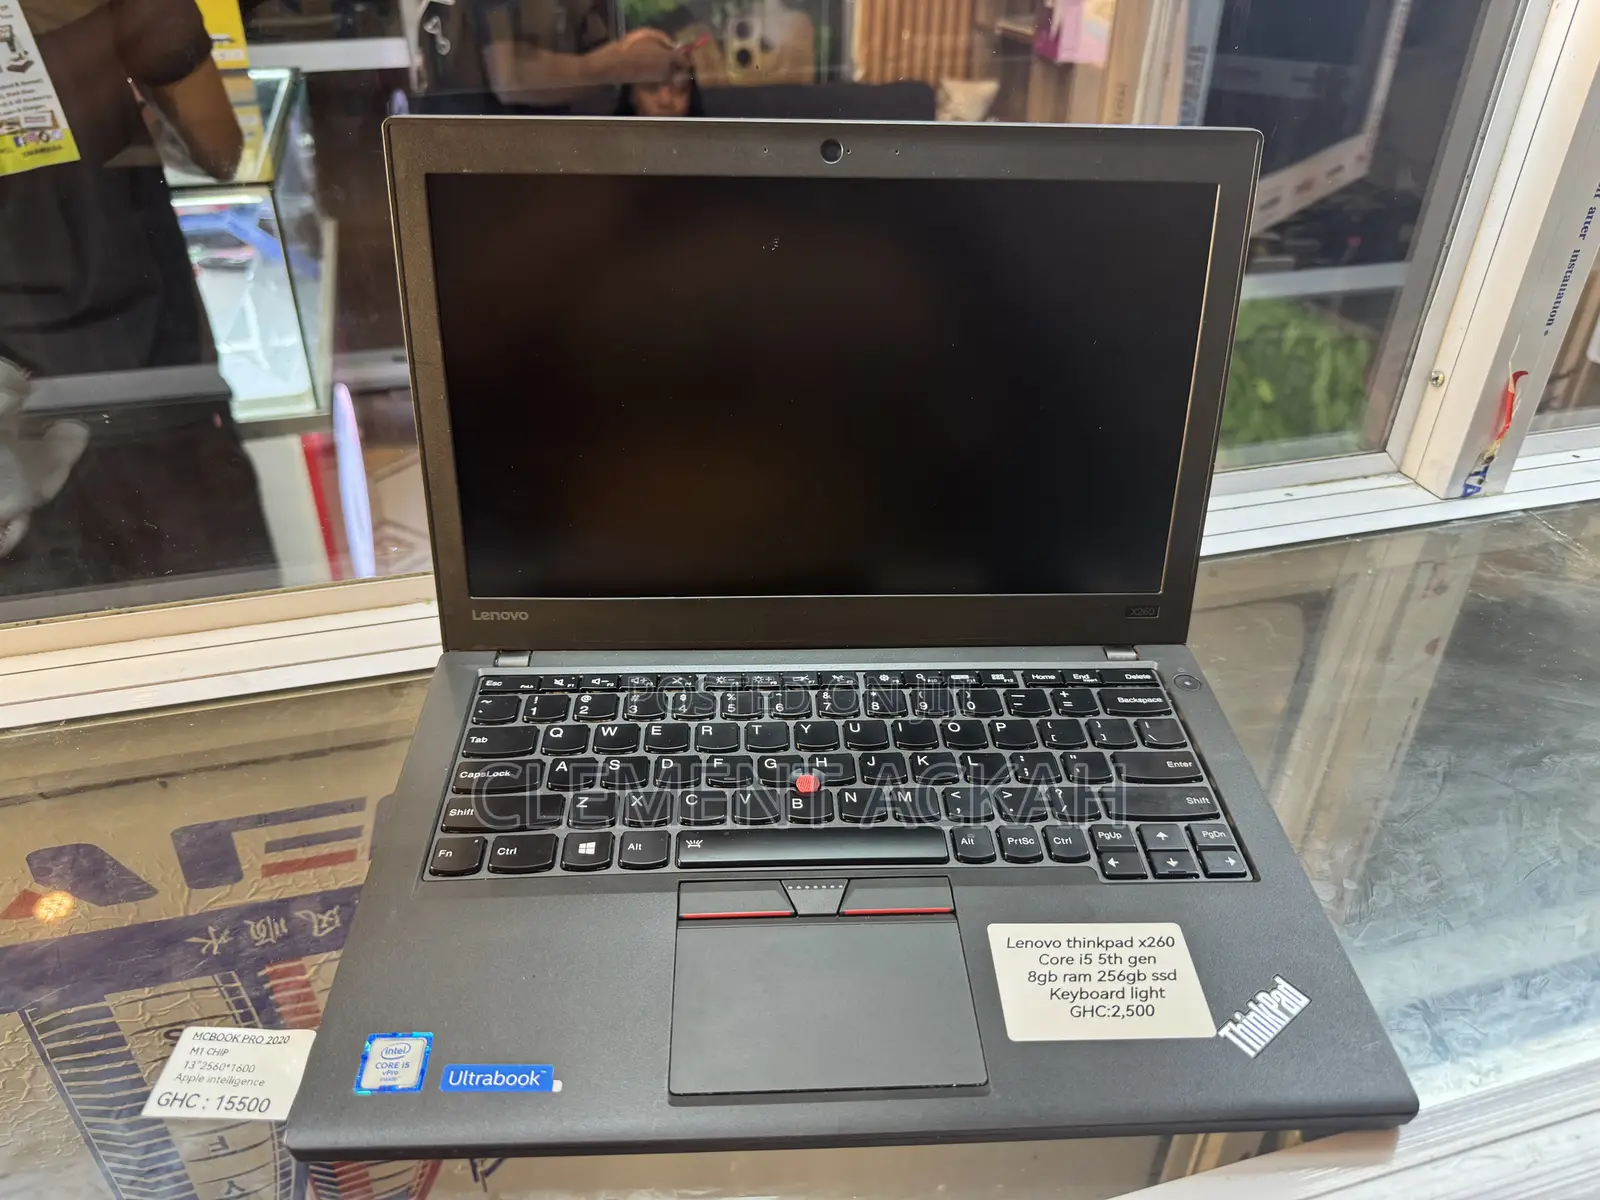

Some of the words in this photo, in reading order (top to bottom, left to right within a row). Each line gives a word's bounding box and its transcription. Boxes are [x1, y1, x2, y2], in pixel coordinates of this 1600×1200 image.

[472, 609, 529, 621] Lenovo
[1117, 696, 1162, 704] Backspace
[579, 705, 589, 714] 2
[628, 705, 638, 714] 3
[678, 704, 688, 713] 4
[727, 703, 736, 712] 5
[775, 703, 784, 711] 6
[823, 702, 832, 711] 7
[871, 701, 880, 710] 8
[919, 701, 928, 710] 9
[530, 706, 537, 716] 1
[601, 726, 618, 736] W
[651, 725, 662, 735] E
[701, 725, 713, 735] R
[751, 725, 762, 734] T
[800, 724, 811, 733] Y
[849, 723, 860, 732] U
[995, 722, 1007, 731] P
[550, 727, 564, 738] Q
[609, 760, 621, 770] S
[661, 759, 674, 769] D
[713, 758, 723, 768] F
[764, 758, 777, 768] G
[816, 757, 828, 767] H
[867, 756, 875, 766] J
[917, 756, 929, 765] K
[968, 756, 978, 765] L
[555, 761, 568, 771] A
[631, 795, 643, 806] X
[685, 794, 698, 805] C
[740, 794, 751, 804] V
[845, 792, 857, 802] N
[898, 791, 912, 802] M
[1186, 796, 1210, 805] Shift
[576, 797, 589, 808] Z
[792, 798, 803, 809] B
[449, 808, 474, 816] Shift
[1098, 831, 1122, 841] PgUp
[1201, 830, 1226, 839] PgDn
[627, 842, 642, 850] Alt
[960, 837, 975, 845] Alt
[1007, 837, 1035, 845] PrtSc
[1053, 837, 1072, 845] Ctrl
[438, 849, 453, 858] Fn
[497, 847, 517, 855] Ctrl
[1006, 936, 1062, 949] Lenovo
[1066, 936, 1134, 952] thinkpad
[1138, 936, 1175, 948] x260
[1038, 953, 1074, 965] Core
[1079, 953, 1093, 965] i5
[1098, 953, 1123, 965] 5th
[1128, 956, 1156, 968] gen
[1027, 970, 1058, 986] 8gb
[1063, 972, 1092, 982] ram
[1097, 970, 1147, 984] 256gb
[1151, 969, 1177, 981] ssd
[1049, 988, 1125, 1003] Keyboard
[1130, 987, 1165, 1003] light
[1070, 1005, 1155, 1020] GHC:2,500
[1218, 974, 1312, 1058] ThinkPad
[192, 1032, 240, 1042] MCBOOK
[241, 1035, 264, 1044] PRO
[265, 1035, 290, 1045] 2020
[189, 1046, 205, 1056] M1
[206, 1047, 229, 1056] CHIP
[384, 1045, 407, 1055] intel
[175, 1073, 205, 1083] Apple
[206, 1076, 266, 1087] intelligence
[157, 1092, 200, 1108] GHC
[216, 1094, 271, 1113] 15500
